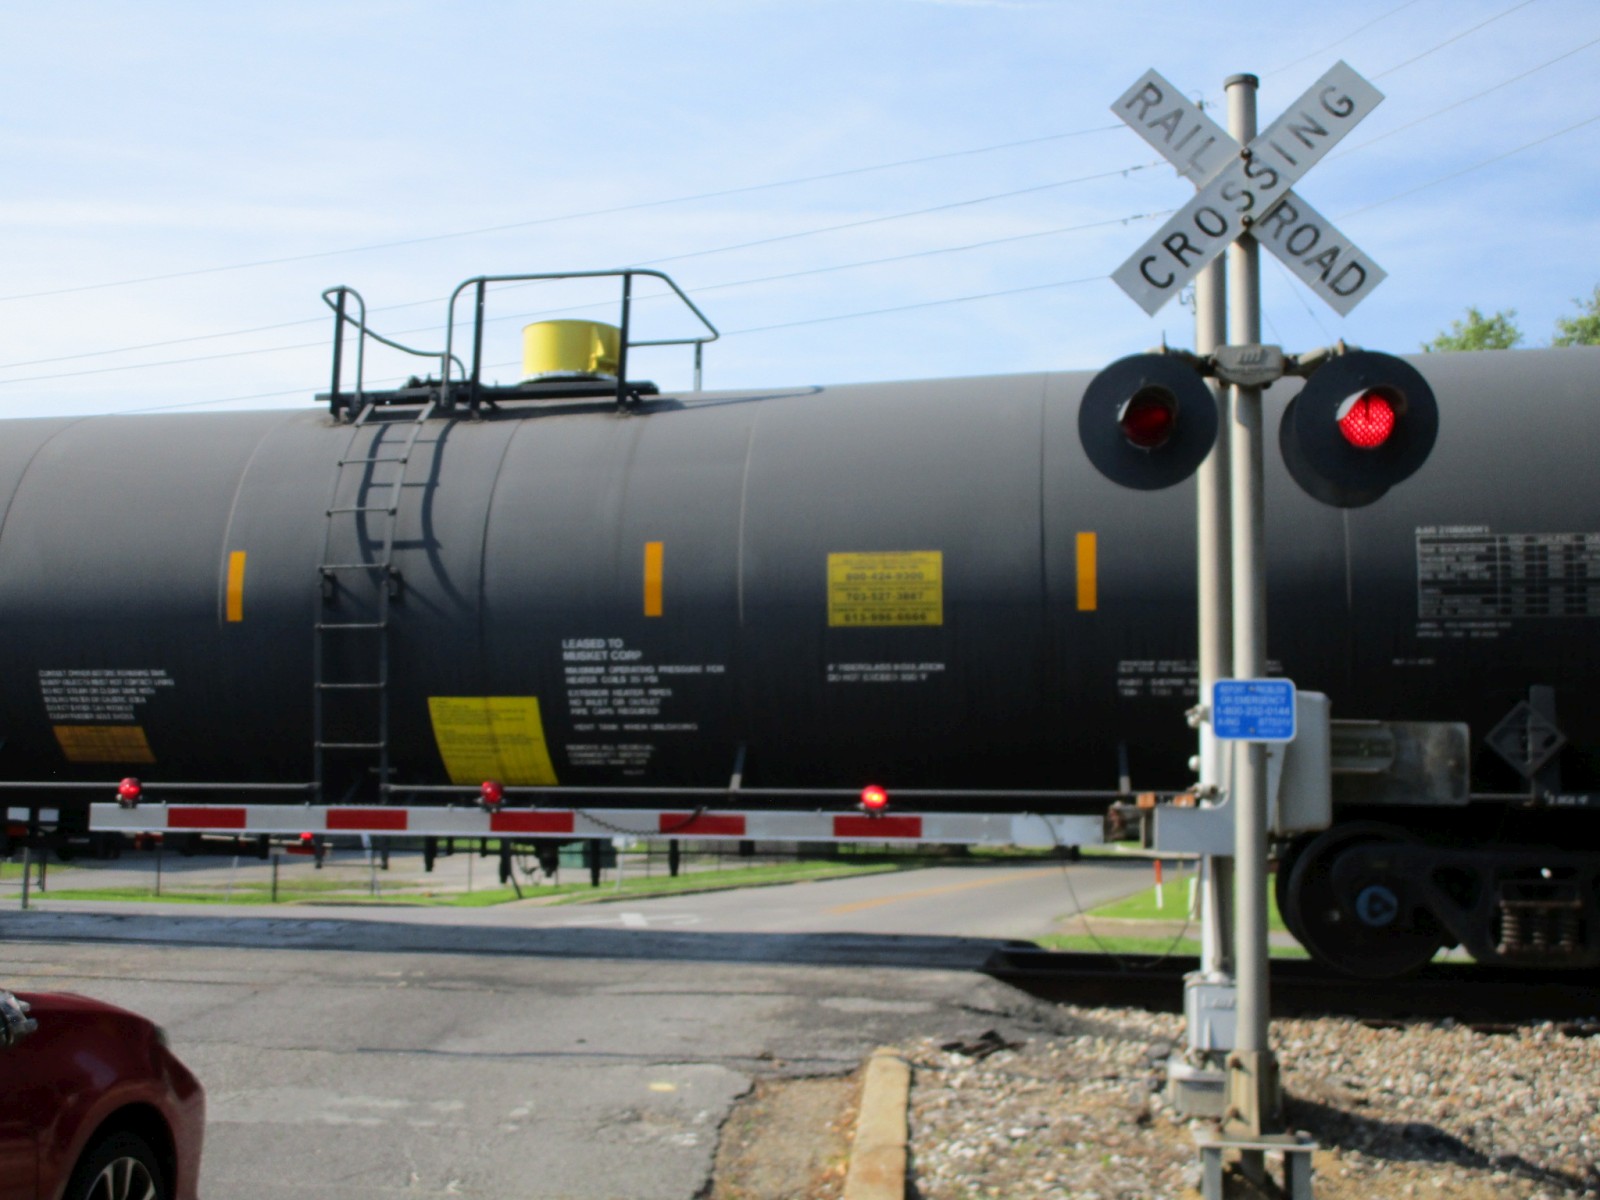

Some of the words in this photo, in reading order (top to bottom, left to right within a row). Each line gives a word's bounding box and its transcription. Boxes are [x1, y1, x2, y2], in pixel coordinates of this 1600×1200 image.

[1125, 82, 1215, 174] RAIL
[1259, 200, 1367, 297] ROAD
[1139, 86, 1355, 290] CROSSING
[562, 638, 605, 649] LEASED
[607, 638, 624, 649] TO
[563, 651, 608, 661] MUSKET
[610, 651, 642, 661] CORP
[658, 665, 702, 675] PRESSURE
